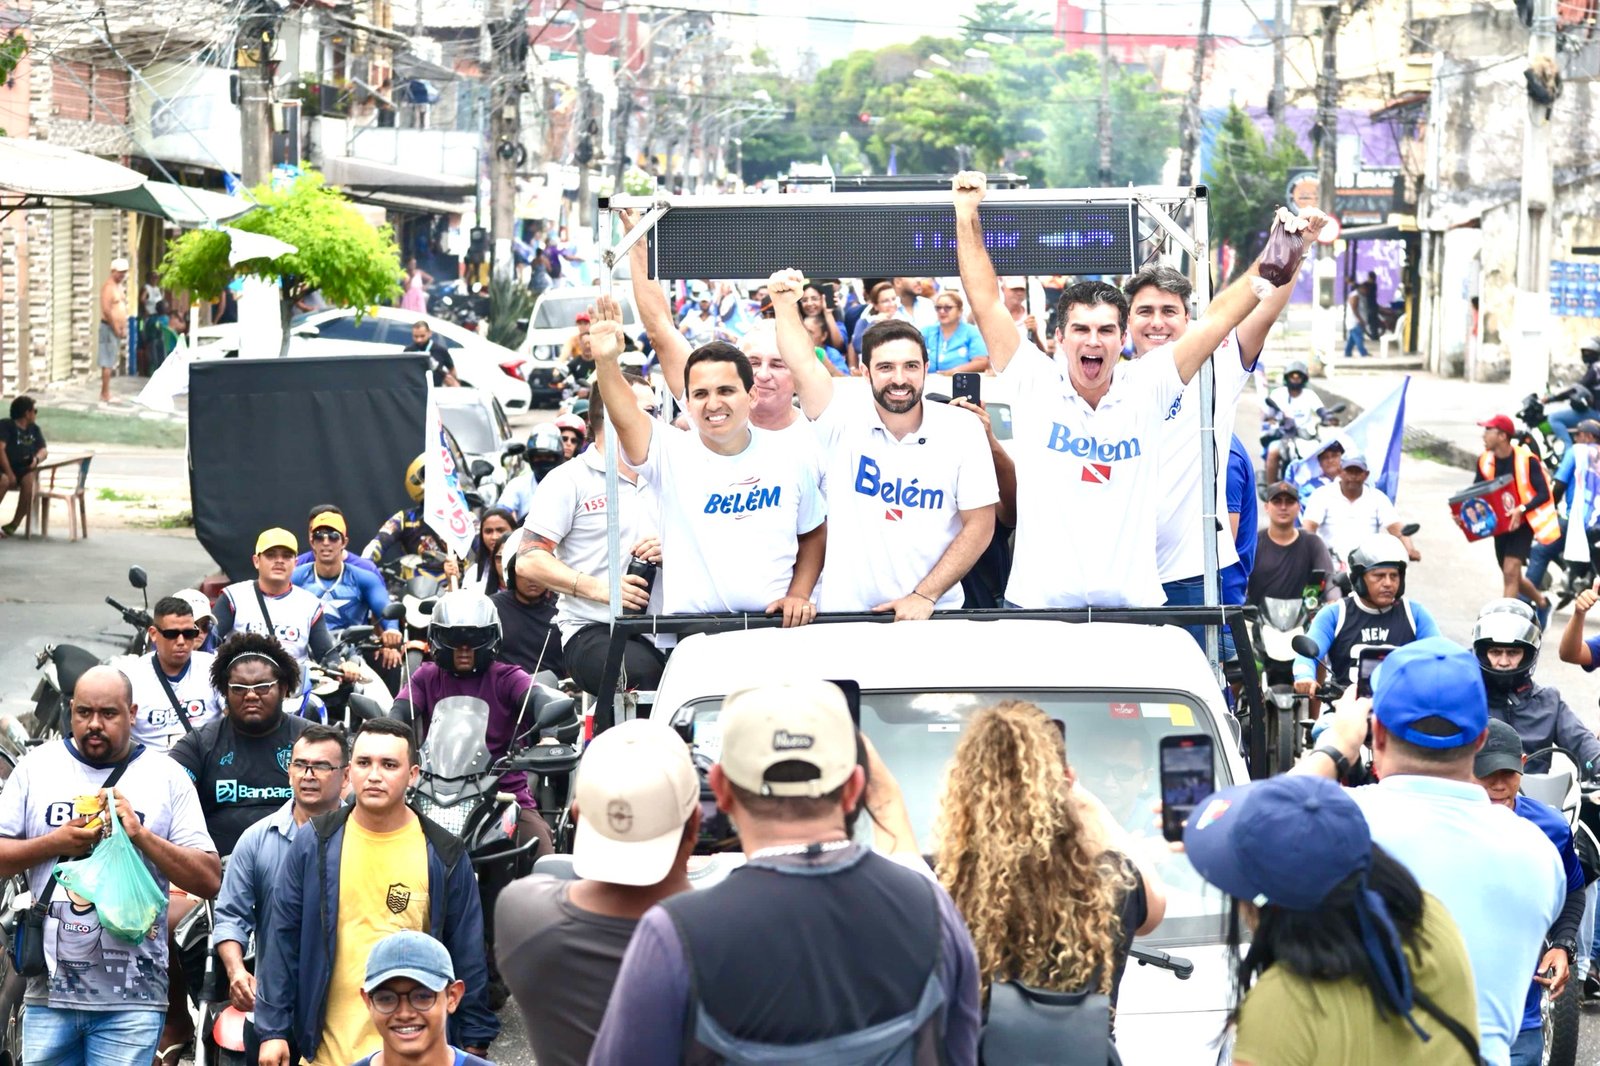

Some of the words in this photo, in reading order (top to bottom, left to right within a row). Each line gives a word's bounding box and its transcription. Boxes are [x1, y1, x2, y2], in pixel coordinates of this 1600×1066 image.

[1047, 421, 1141, 463] Belém
[855, 454, 944, 510] Belém
[584, 496, 609, 512] 155
[703, 484, 781, 514] BELÉM
[1361, 627, 1389, 642] NEW
[64, 923, 90, 933] BIECO
